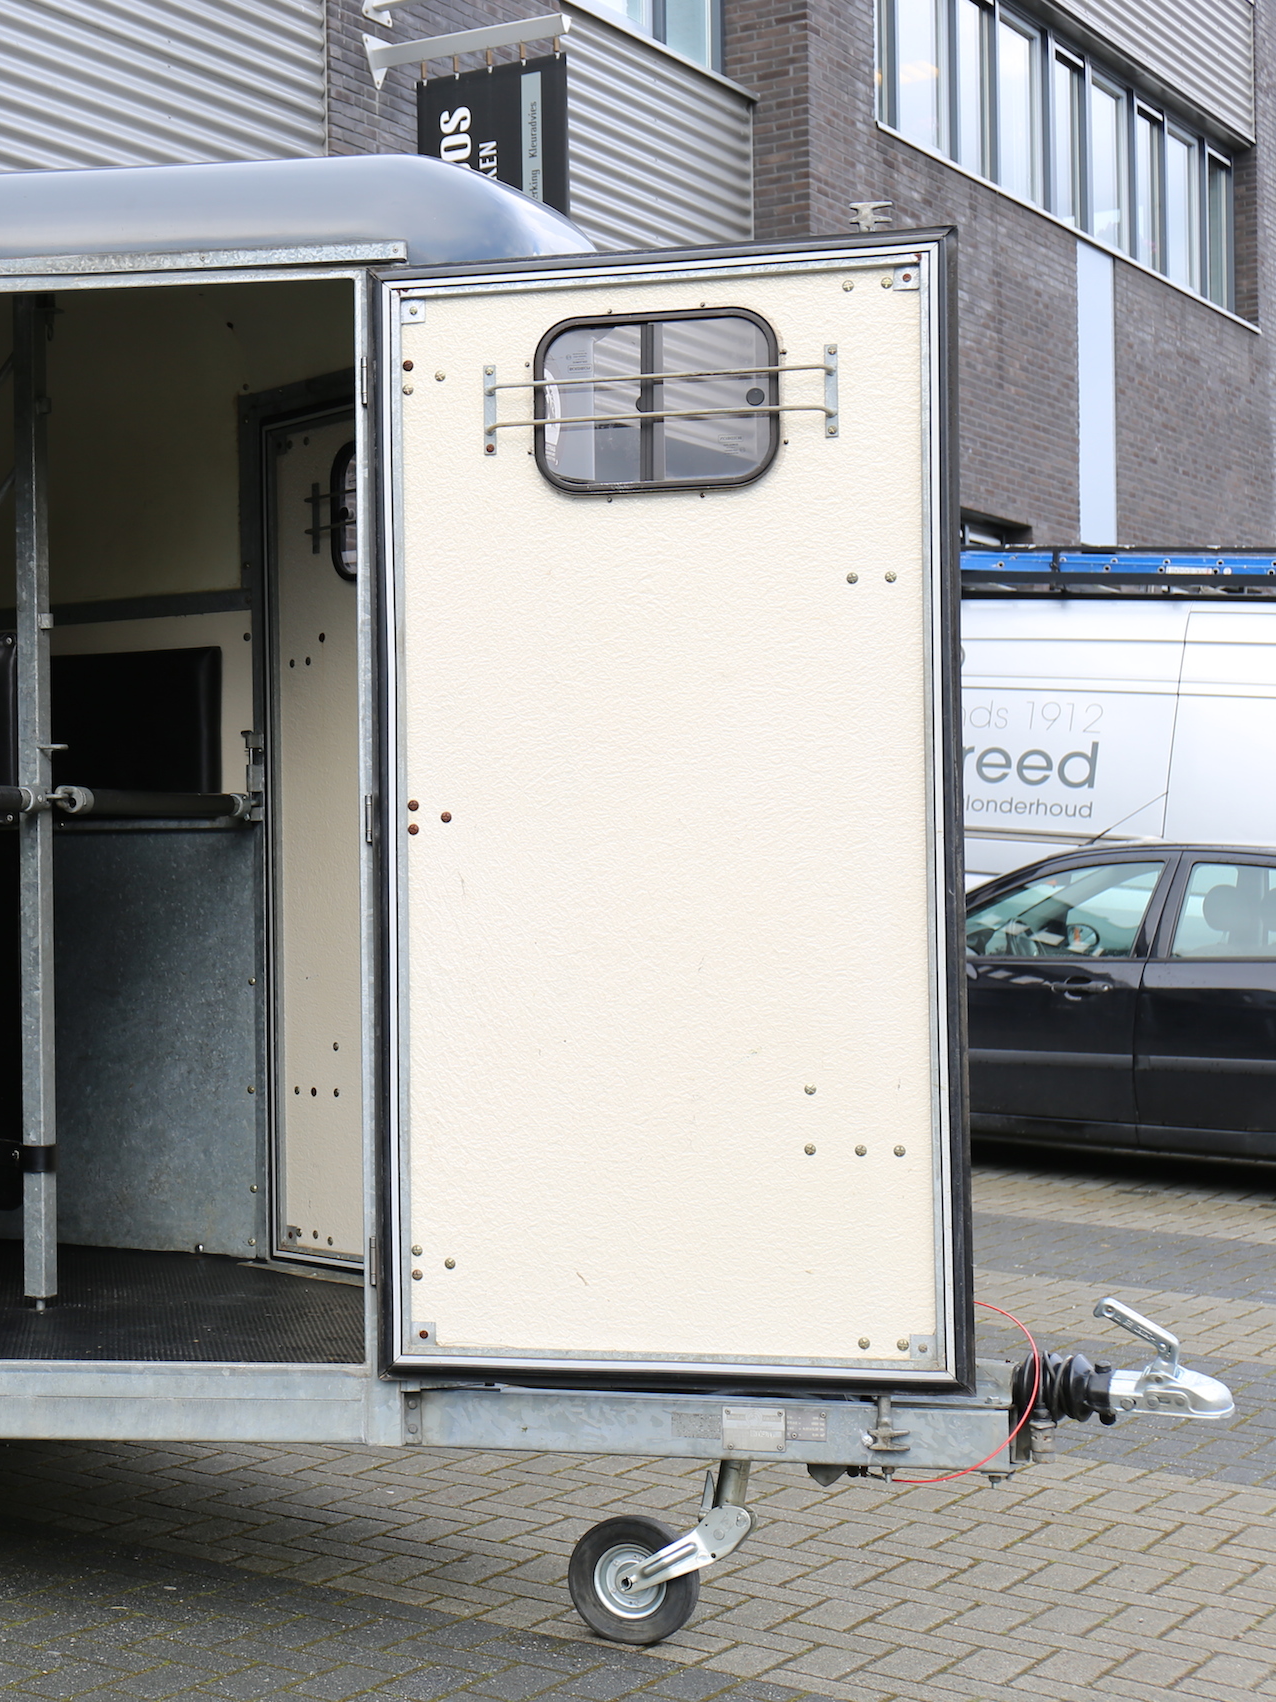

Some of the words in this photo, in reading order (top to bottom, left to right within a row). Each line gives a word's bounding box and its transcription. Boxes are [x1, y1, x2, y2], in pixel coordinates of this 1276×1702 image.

[440, 106, 472, 169] OS
[528, 101, 538, 159] Kleuradvies
[1026, 701, 1104, 734] 1912
[961, 741, 1099, 789] reed
[966, 794, 1094, 819] londerhoud
